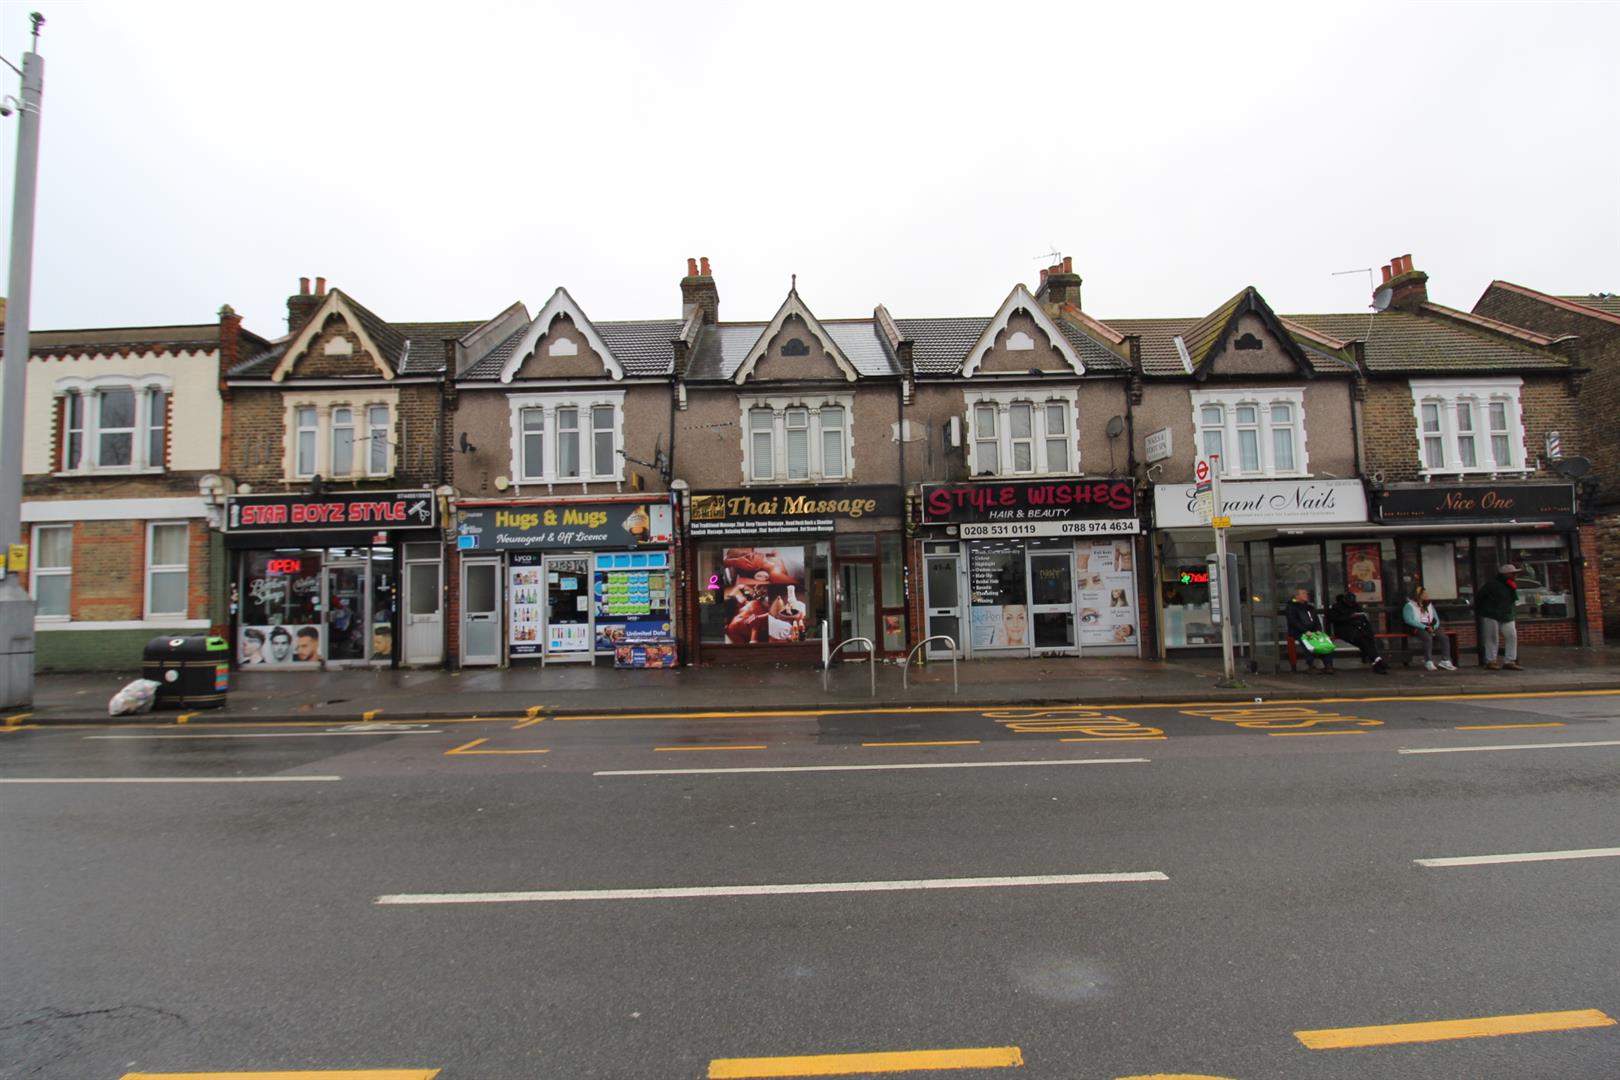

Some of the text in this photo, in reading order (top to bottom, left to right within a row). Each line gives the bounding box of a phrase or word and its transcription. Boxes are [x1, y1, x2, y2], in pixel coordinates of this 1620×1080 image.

[727, 495, 876, 518] Thai Massage
[927, 482, 1132, 515] STYLE WISHES
[1186, 485, 1335, 513] Eant Nails
[1436, 491, 1514, 511] Nice One
[241, 501, 407, 524] STAR BOYZ STYLE
[495, 511, 539, 531] Hugs
[543, 509, 557, 526] &
[562, 509, 608, 528] Mugs
[989, 508, 1070, 519] HAIR & BEAUTY
[964, 526, 989, 535] 0208
[991, 525, 1009, 535] 531
[1012, 524, 1036, 534] 0119
[1062, 522, 1134, 533] 0788 974 4634
[496, 531, 608, 545] Newsagent & Off Licence
[268, 559, 300, 573] OPEN
